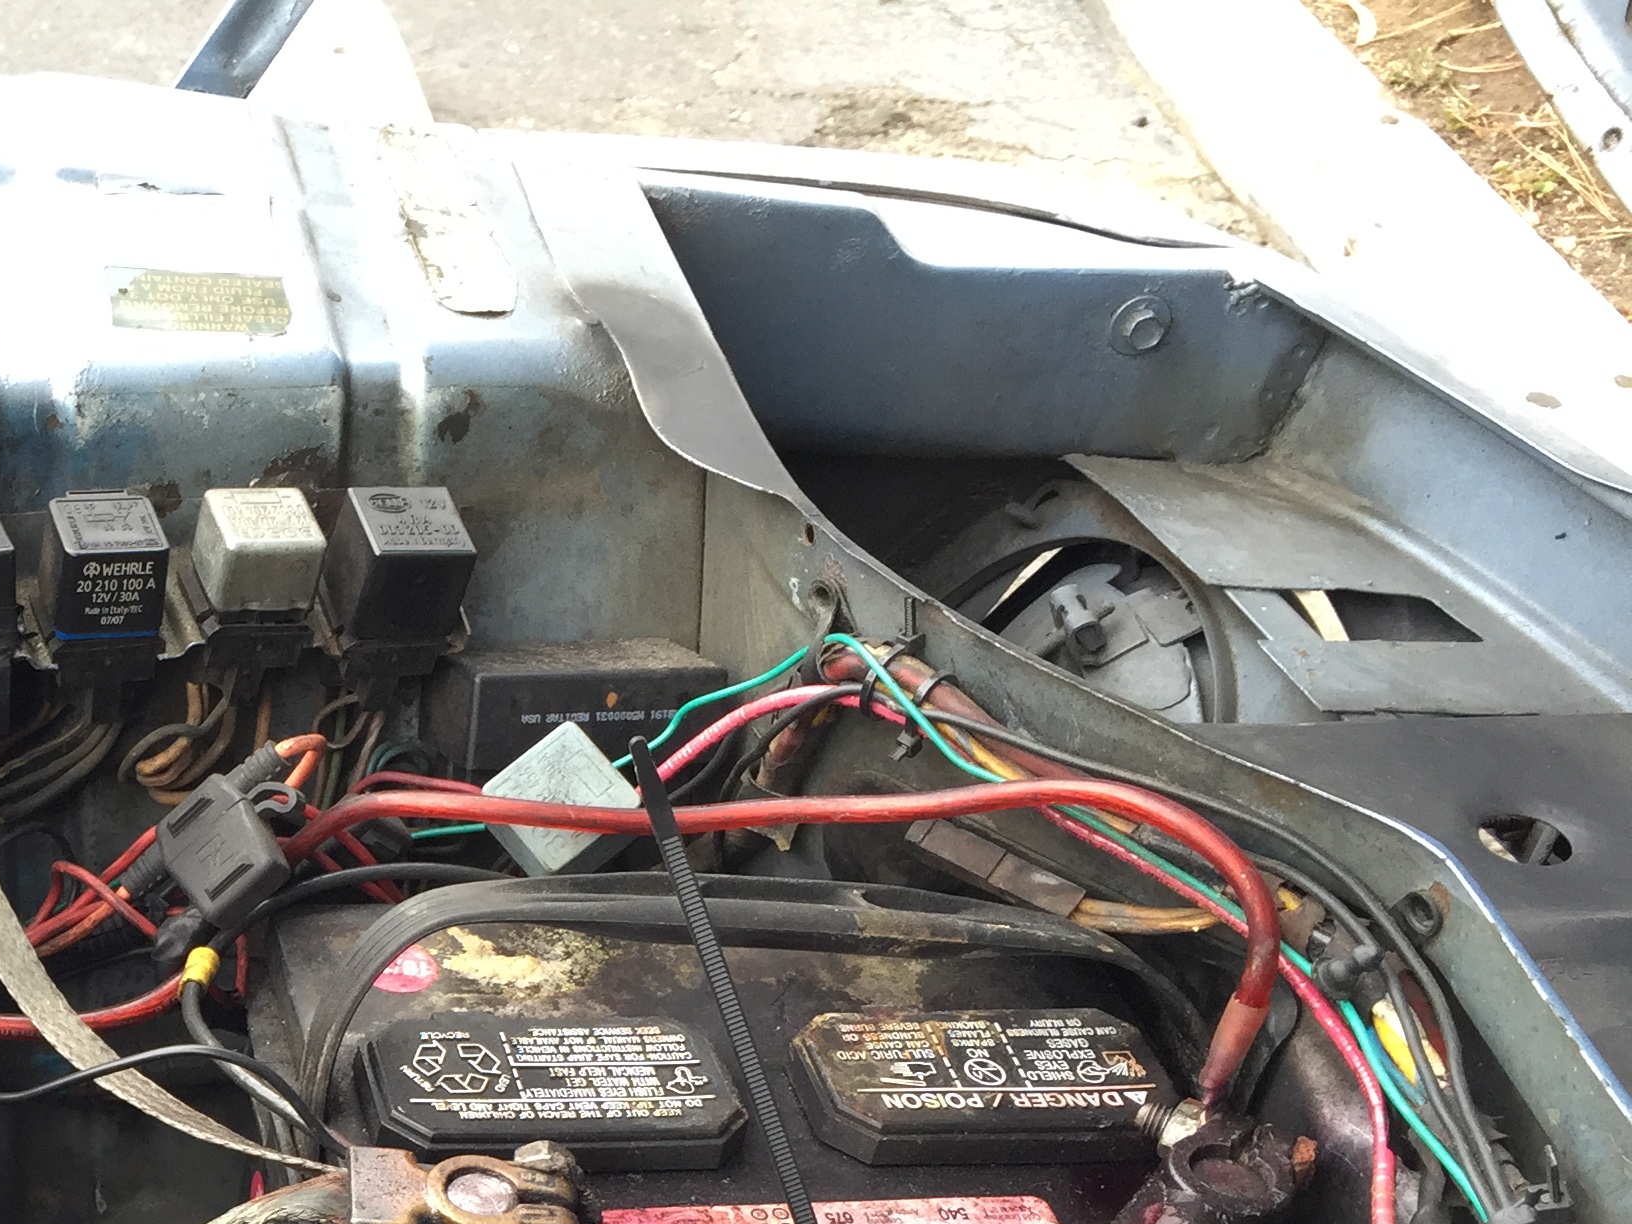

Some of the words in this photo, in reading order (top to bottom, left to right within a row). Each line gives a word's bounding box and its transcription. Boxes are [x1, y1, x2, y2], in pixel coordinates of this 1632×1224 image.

[140, 283, 151, 292] A
[158, 284, 207, 294] FROM
[213, 287, 262, 296] FLUID
[188, 294, 234, 302] ONLY
[119, 300, 212, 312] REMOVING
[218, 305, 289, 314] BEFORE
[176, 313, 223, 321] FILLE
[230, 315, 288, 323] CLEAN
[102, 562, 154, 576] WEHRLE
[76, 580, 92, 592] 20
[95, 579, 117, 592] 210
[123, 578, 143, 590] 100
[146, 578, 156, 589] A
[92, 593, 110, 602] 12V
[119, 592, 140, 602] 30A
[101, 616, 124, 624] 07/07
[521, 714, 541, 723] USA
[879, 1022, 920, 1031] SEVERE
[1029, 1019, 1063, 1027] INJURY
[1066, 1018, 1082, 1026] OR
[592, 1027, 632, 1035] SERVICE
[838, 1023, 876, 1032] BURNS
[1005, 1028, 1060, 1036] BLINDNESS
[1061, 1027, 1094, 1035] CAUSE
[1095, 1026, 1117, 1035] CAN
[419, 1031, 470, 1040] RECYCLE
[862, 1032, 925, 1041] BLINDNESS
[947, 1029, 991, 1038] FLAMES
[510, 1037, 559, 1045] AVAILABLE
[864, 1041, 903, 1049] CAUSE
[951, 1039, 995, 1047] SPARKS
[1046, 1038, 1090, 1048] GASES
[517, 1045, 556, 1053] VEHICLE
[558, 1045, 570, 1053] IN
[572, 1044, 643, 1052] INSTRUCTIONS
[645, 1043, 686, 1052] FOLLOW
[516, 1053, 564, 1062] STARTING
[567, 1053, 594, 1061] JUMP
[596, 1053, 622, 1061] SAFE
[624, 1052, 644, 1061] FOR
[836, 1050, 866, 1060] ACID
[870, 1049, 935, 1059] SULFURIC
[966, 1048, 990, 1058] NO
[1023, 1049, 1095, 1059] EXPLOSIVE
[1034, 1060, 1070, 1070] EYES
[549, 1067, 576, 1077] FAST
[578, 1067, 605, 1076] HELP
[607, 1066, 655, 1076] MEDICAL
[1026, 1070, 1075, 1080] SHIELD
[399, 1065, 435, 1092] RETURN
[565, 1078, 587, 1086] GET
[630, 1076, 660, 1086] WITH
[525, 1088, 595, 1099] IMMEDIATELY
[597, 1087, 627, 1097] EYES
[630, 1086, 664, 1096] FLUSH
[685, 1099, 703, 1107] DO
[880, 1092, 982, 1108] POISON
[992, 1093, 1003, 1108] /
[1010, 1091, 1123, 1107] DANGER
[431, 1102, 467, 1111] LEVEL
[469, 1103, 493, 1111] AND
[497, 1103, 530, 1111] TIGHT
[534, 1102, 565, 1110] CAPS
[568, 1101, 598, 1110] VENT
[601, 1101, 630, 1109] KEEP
[658, 1100, 682, 1108] NOT
[459, 1111, 515, 1119] CHILDREN
[519, 1111, 535, 1119] OF
[538, 1110, 576, 1118] REACH
[579, 1110, 602, 1118] THE
[626, 1109, 650, 1117] OUT
[653, 1108, 682, 1116] KEEP
[937, 1207, 969, 1221] 540
